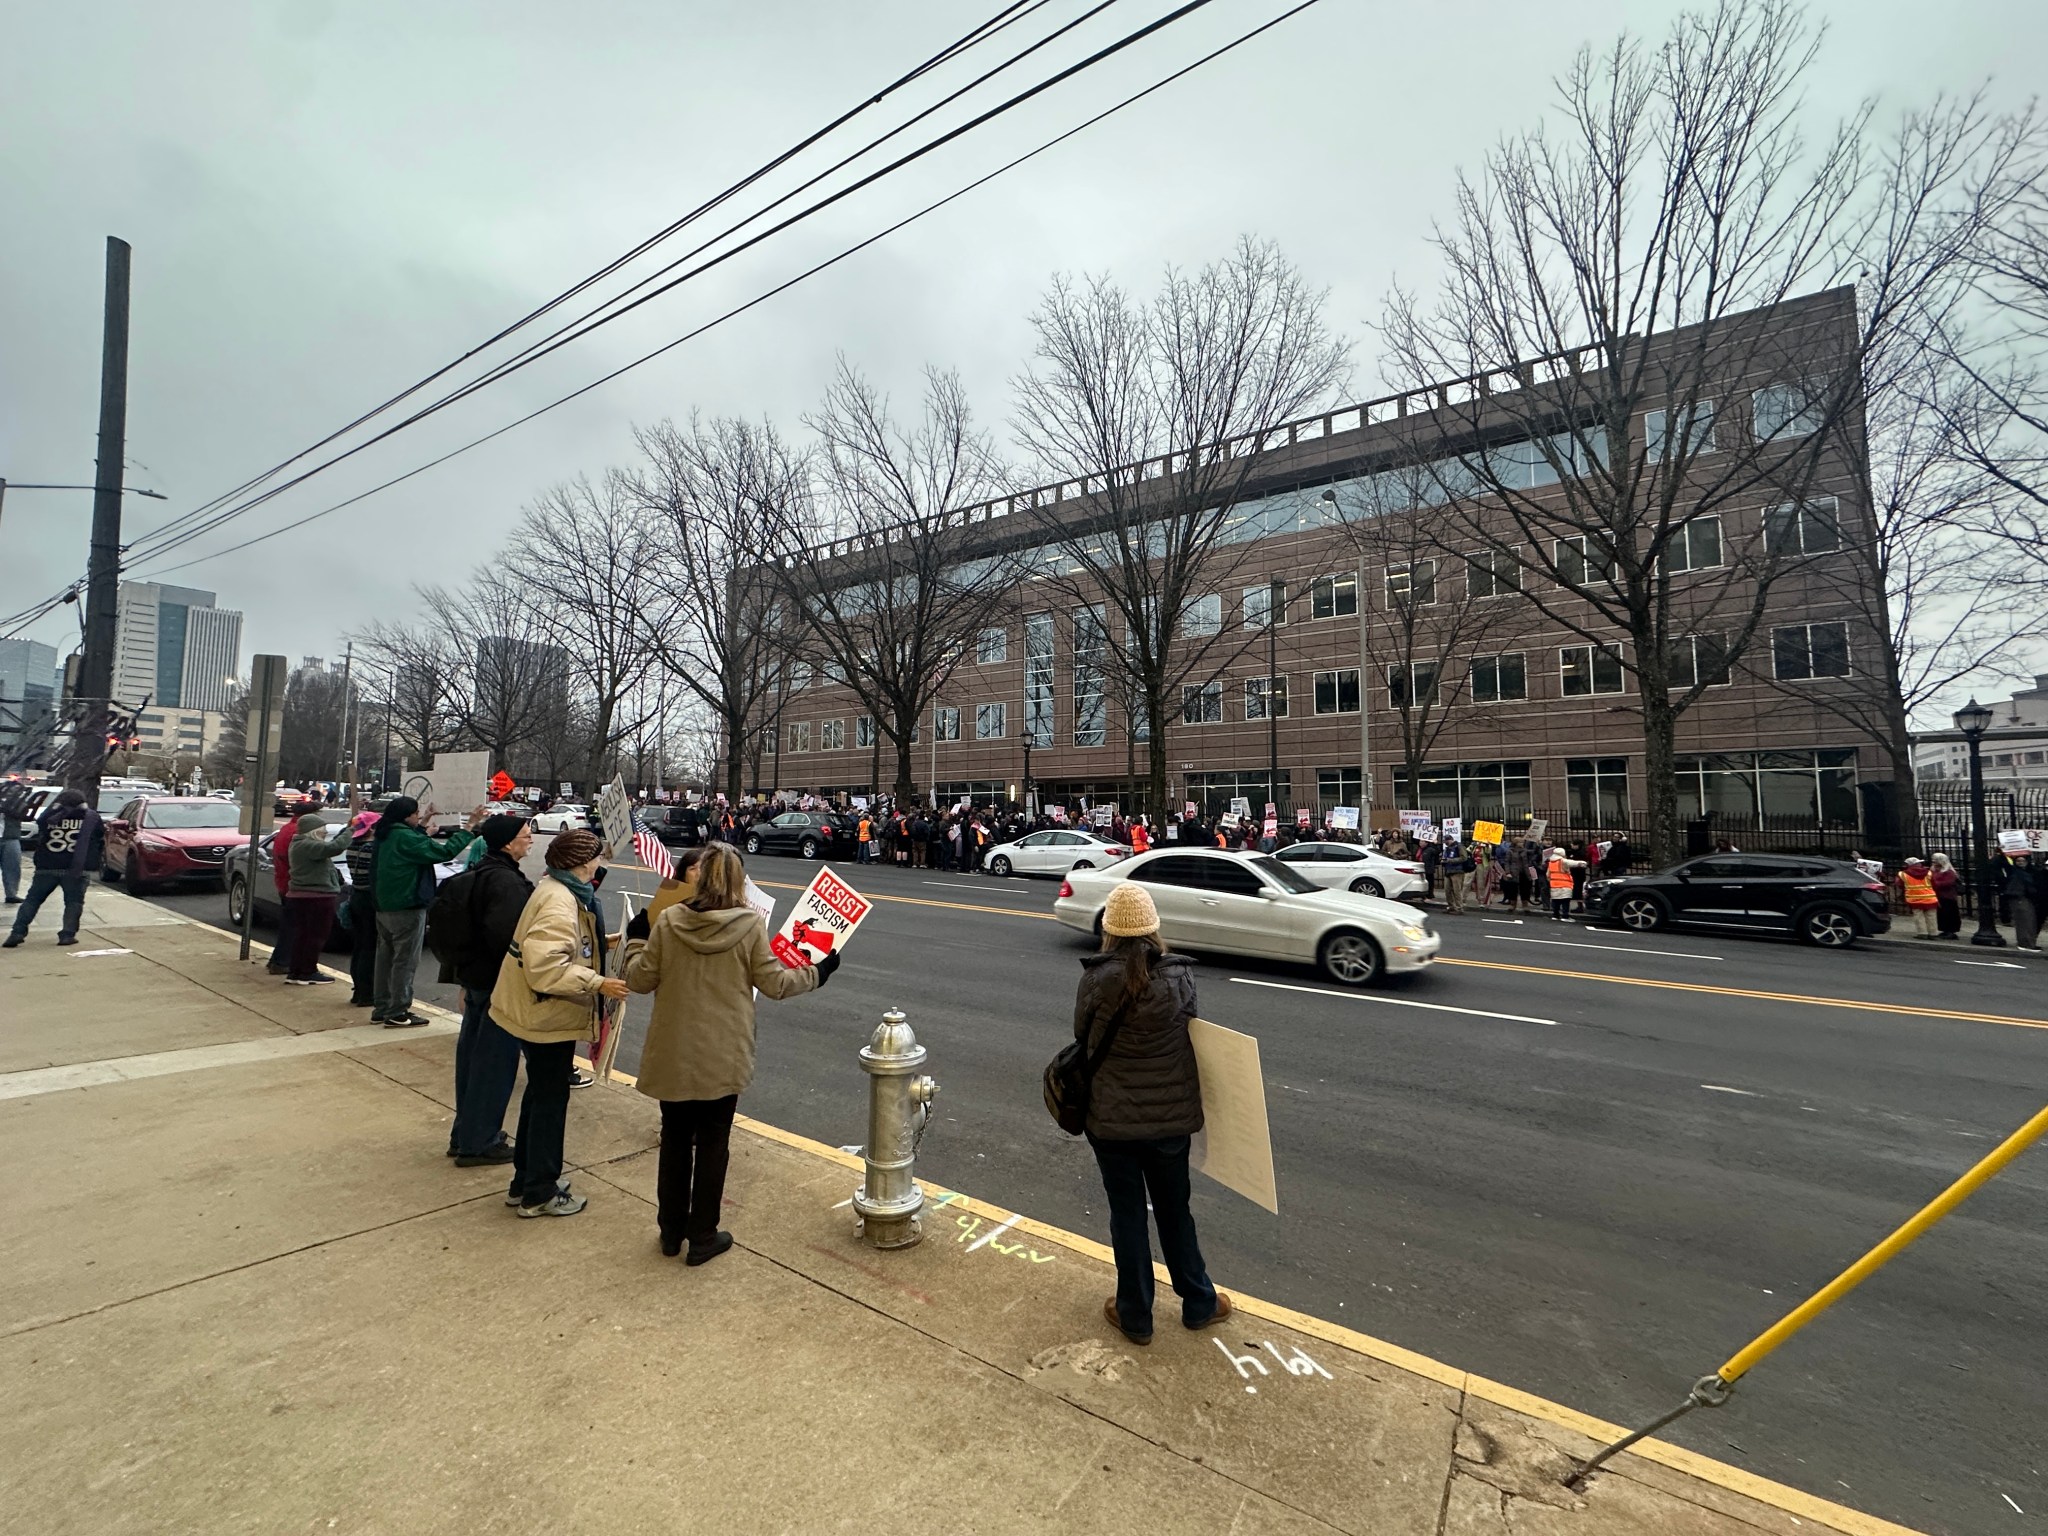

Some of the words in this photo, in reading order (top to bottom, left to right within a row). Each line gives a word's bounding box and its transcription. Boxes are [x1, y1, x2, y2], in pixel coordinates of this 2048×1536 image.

[609, 809, 628, 847] ICE
[1417, 823, 1438, 834] FUCK
[1419, 831, 1433, 840] ICE
[807, 894, 850, 934] FASCISM
[817, 876, 864, 919] RESIST
